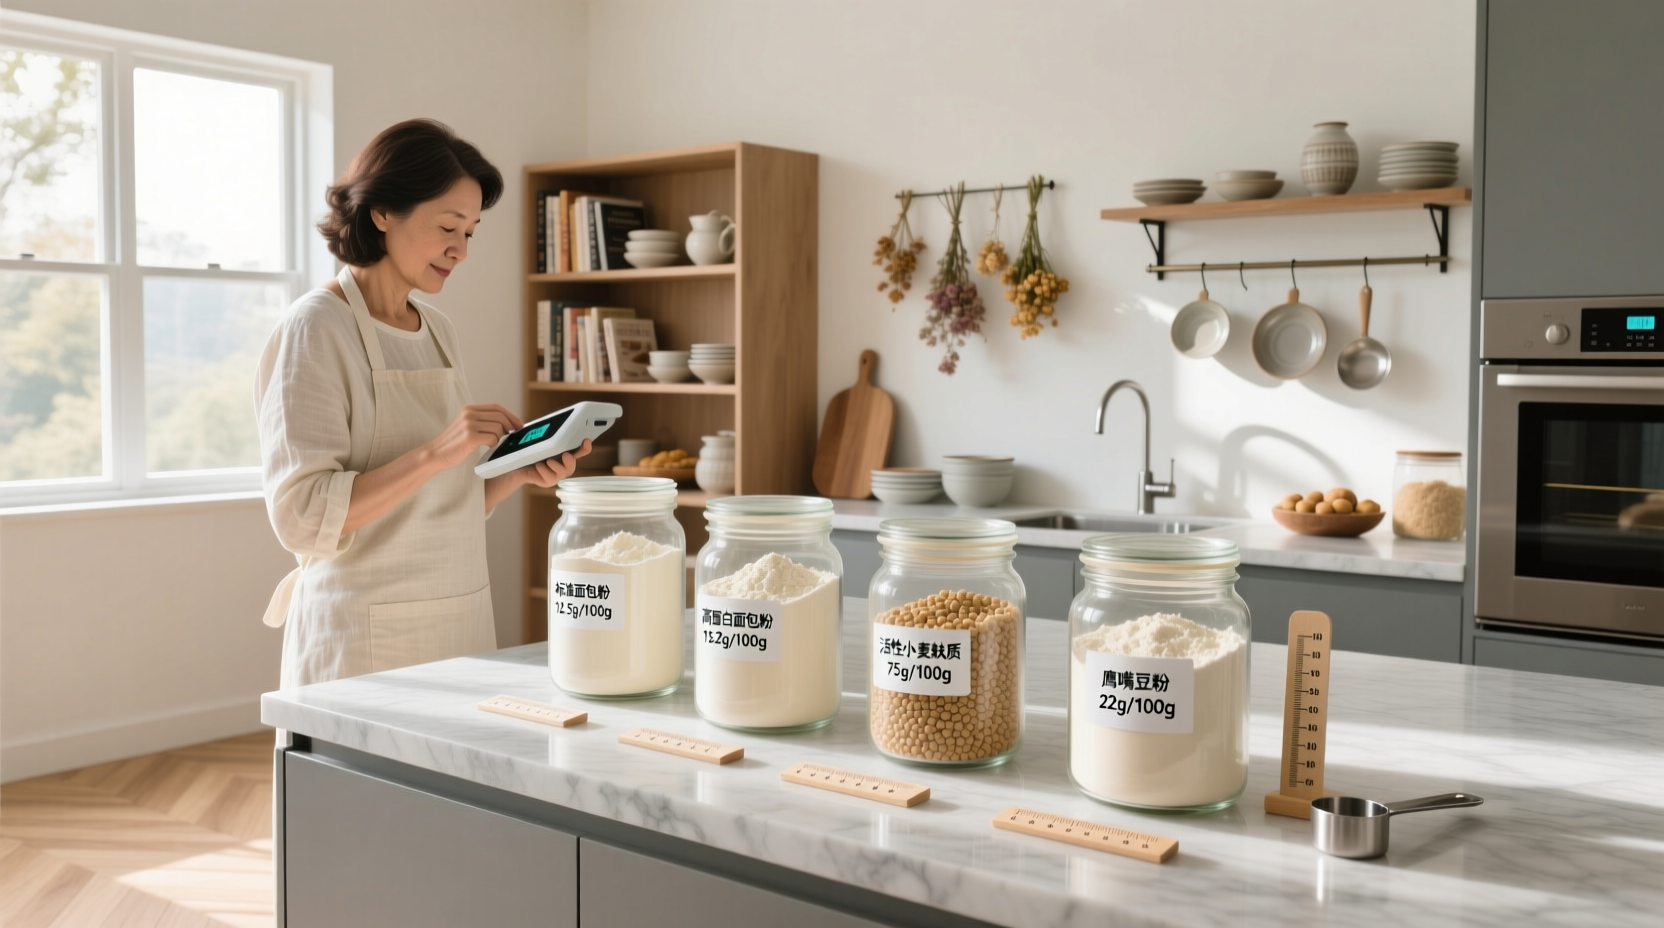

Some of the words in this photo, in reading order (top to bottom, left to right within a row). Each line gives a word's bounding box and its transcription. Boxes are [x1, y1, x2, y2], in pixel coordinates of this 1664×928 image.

[887, 661, 952, 684] 75g/100g
[1101, 669, 1170, 692] 鹰嘴豆粉
[1099, 693, 1175, 720] 22g/100g
